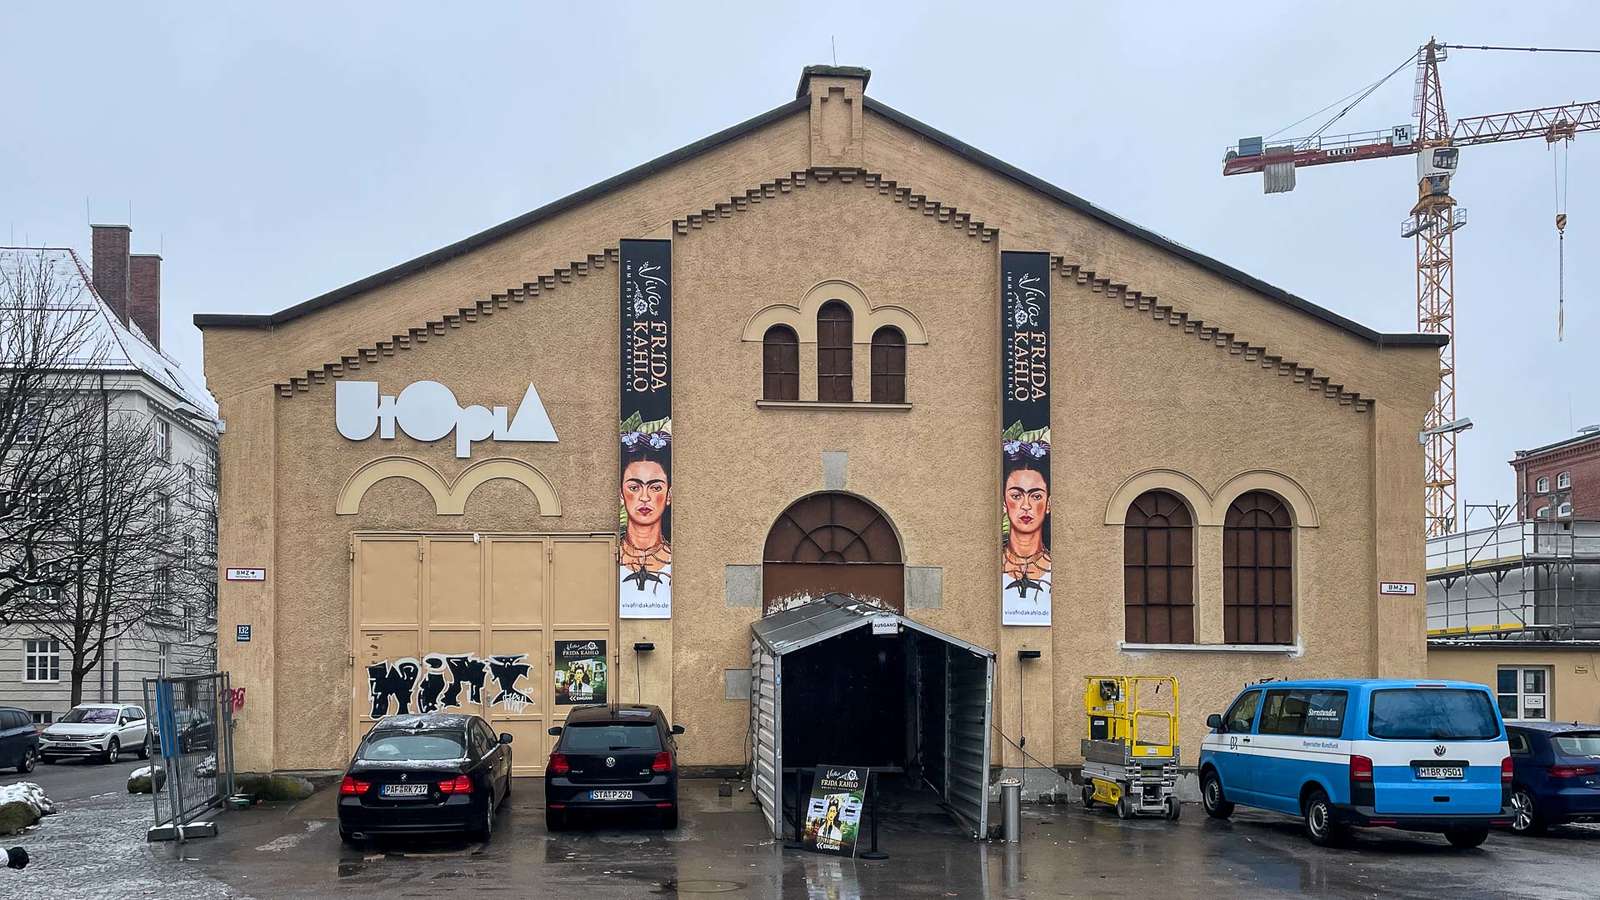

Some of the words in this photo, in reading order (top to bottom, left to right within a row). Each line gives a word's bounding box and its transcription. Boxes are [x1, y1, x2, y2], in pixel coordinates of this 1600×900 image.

[638, 265, 667, 316] Viva
[1018, 276, 1046, 327] Viva
[633, 320, 649, 392] KAHLO
[650, 320, 668, 392] FRIDA
[1014, 331, 1030, 402] KAHLO
[1030, 331, 1047, 402] FRIDA
[238, 626, 249, 634] 132
[821, 779, 838, 787] FRIDA
[839, 780, 859, 789] KAHLO
[1442, 767, 1462, 777] 9501
